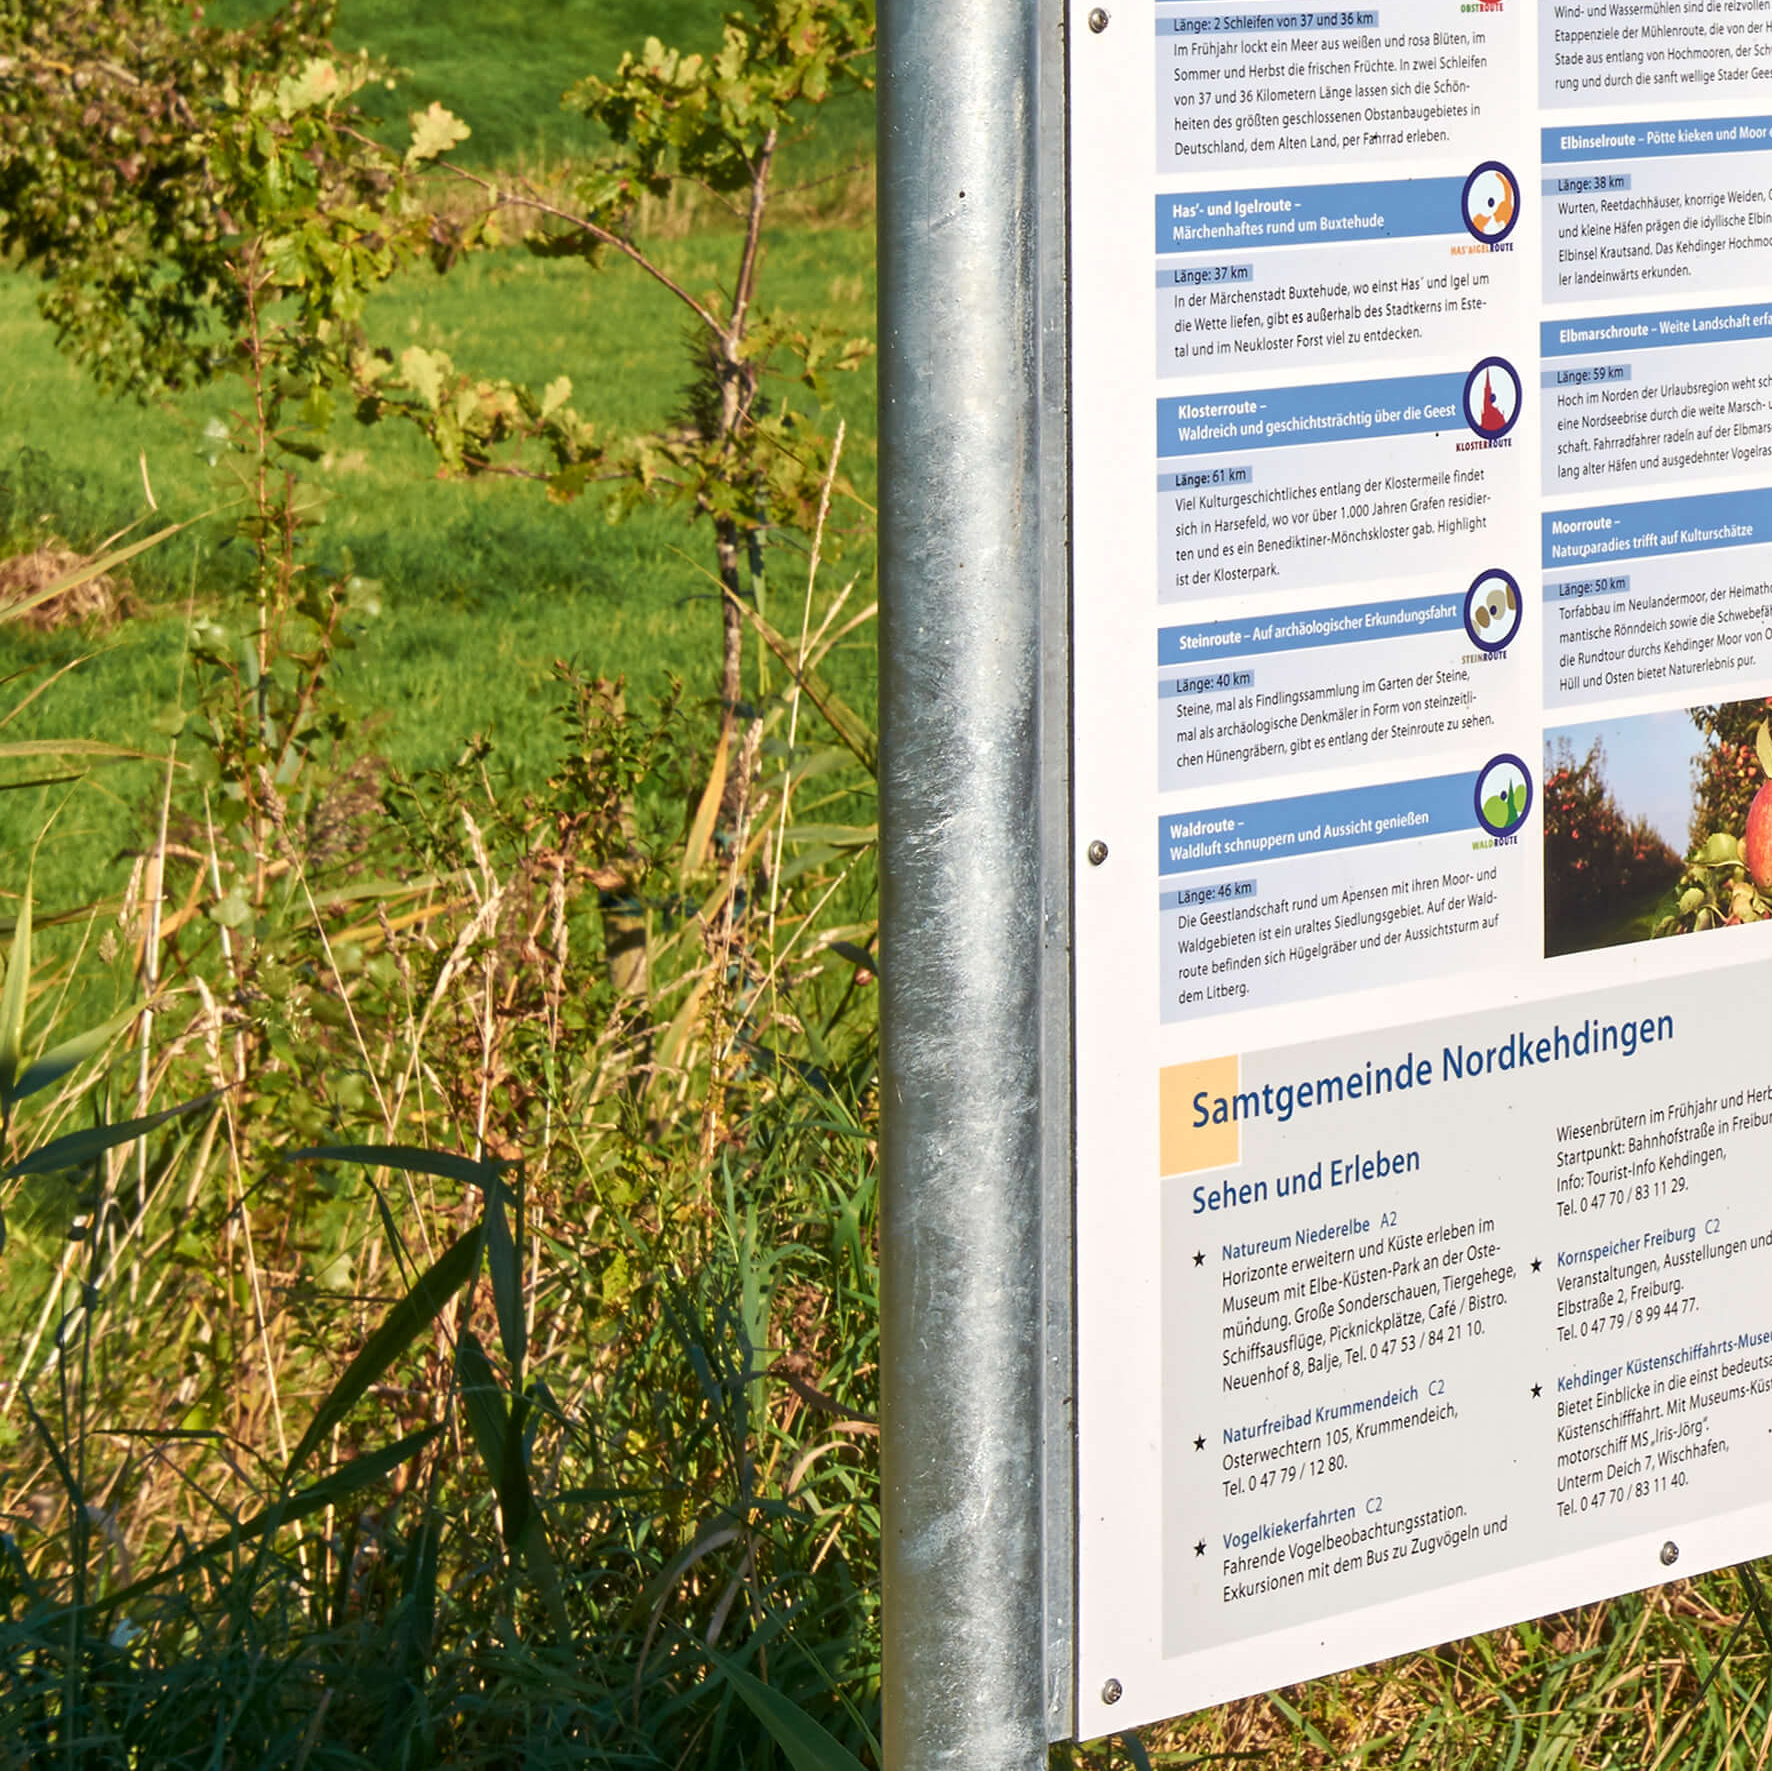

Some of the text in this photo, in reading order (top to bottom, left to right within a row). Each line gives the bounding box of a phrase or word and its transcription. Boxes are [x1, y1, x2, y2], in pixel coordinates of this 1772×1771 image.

[1193, 1015, 1673, 1129] Samtgemeinde Nordkehdingen
[1192, 1150, 1420, 1215] Sehen und Erleben
[1222, 1210, 1397, 1261] Natureum Niederelbe A2
[1557, 1217, 1720, 1268] Kornspeicher Freiburg C2
[1557, 1366, 1623, 1393] Kehdinger
[1223, 1378, 1445, 1445] Naturfreibad Krummendeich C2
